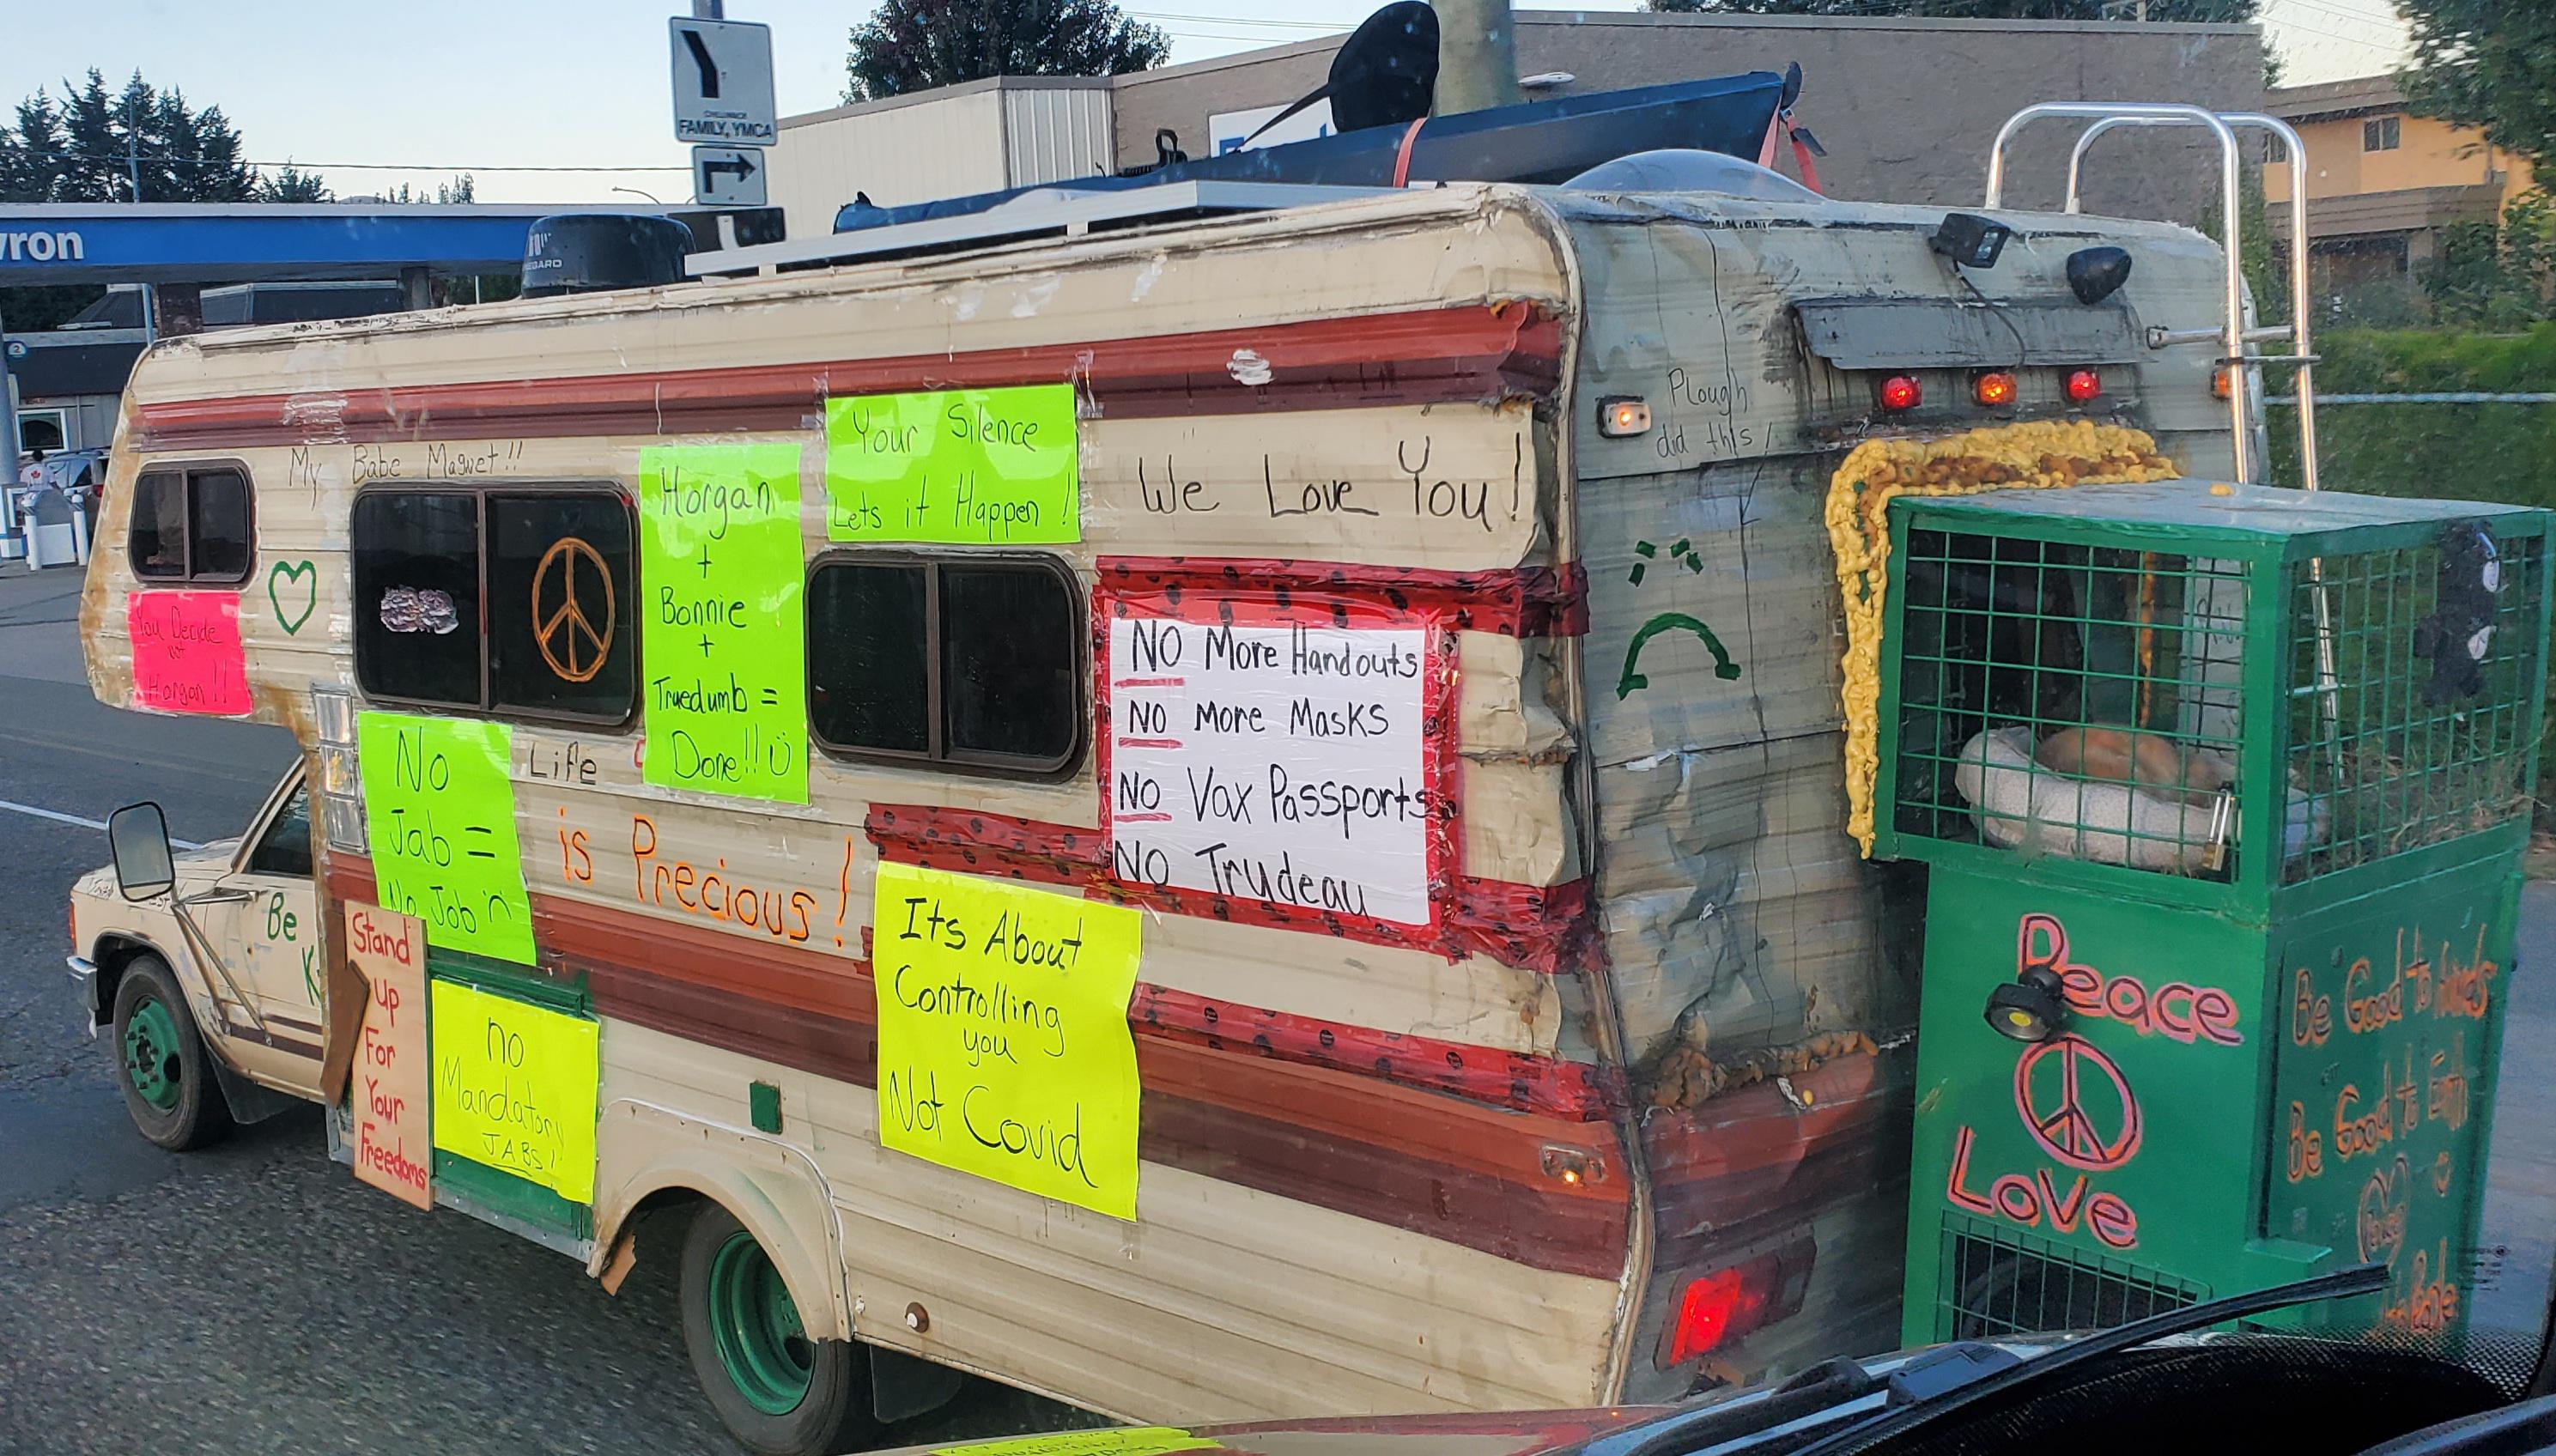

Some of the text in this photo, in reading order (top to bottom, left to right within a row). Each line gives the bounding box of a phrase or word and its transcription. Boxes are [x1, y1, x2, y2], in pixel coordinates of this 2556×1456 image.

[733, 123, 772, 137] YMCA
[13, 345, 21, 354] 2
[853, 403, 1039, 454] Your Silence
[1656, 424, 1689, 458] did
[288, 446, 322, 511] My
[352, 444, 401, 484] Babe
[661, 466, 772, 540] Horgan
[834, 491, 883, 530] Lets
[906, 474, 930, 529] it
[1138, 453, 1221, 515] We
[1265, 453, 1380, 519] Love
[137, 605, 222, 644] You Decide
[661, 586, 747, 628] Bonnie
[1205, 625, 1279, 671] More
[1291, 621, 1418, 679] Handouts
[653, 672, 748, 715] Truedumb
[1194, 701, 1266, 733] More
[396, 725, 449, 792] No
[529, 740, 598, 786] Life
[1270, 763, 1432, 840] Passports
[389, 809, 451, 867] Jab
[559, 807, 591, 884] is
[388, 878, 477, 934] No Job
[1194, 842, 1370, 921] Trudeau
[268, 891, 297, 941] Be
[352, 911, 411, 967] Stand
[899, 898, 1083, 971] Its About
[374, 978, 399, 1028] Up
[2018, 913, 2245, 1047] Peace
[2293, 968, 2332, 1046] Be
[2345, 925, 2404, 1034] Good
[895, 964, 1065, 1058] Controlling
[365, 1026, 396, 1070] For
[962, 1027, 1017, 1068] you
[365, 1074, 405, 1125] Your
[441, 1055, 566, 1162] Mandatory
[889, 1065, 1099, 1189] Not Covid
[2287, 1100, 2322, 1184] Be
[2334, 1059, 2394, 1161] Good
[360, 1121, 427, 1191] Freedoms
